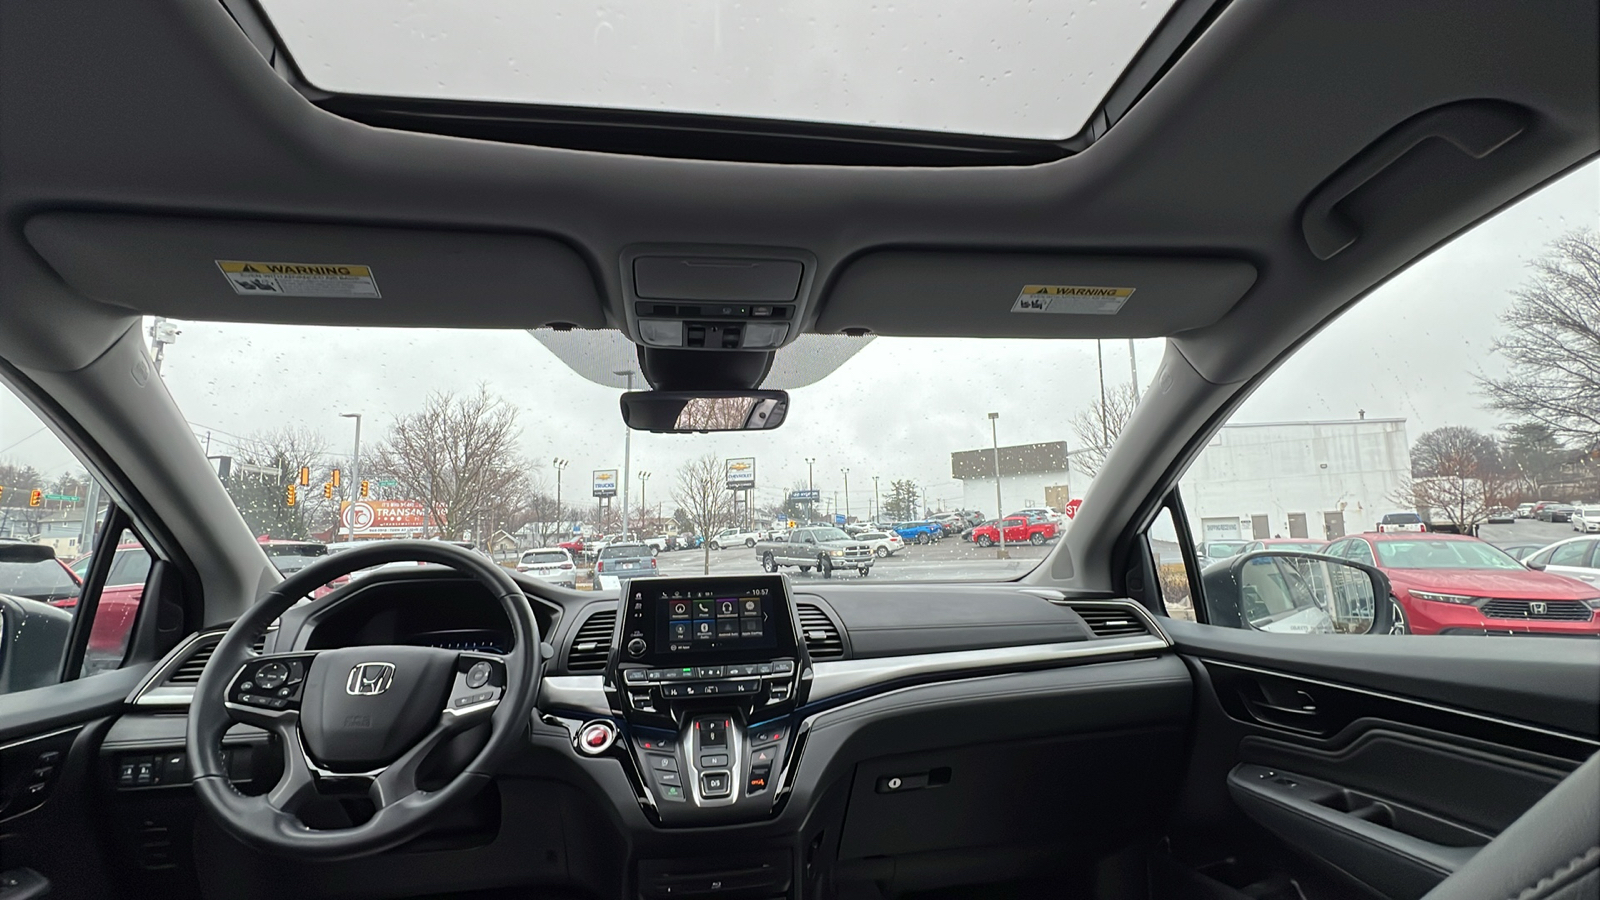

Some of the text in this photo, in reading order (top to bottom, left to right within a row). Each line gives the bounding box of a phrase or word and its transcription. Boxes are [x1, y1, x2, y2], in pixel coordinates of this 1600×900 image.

[266, 264, 351, 275] WARNING
[1056, 287, 1118, 296] WARNING
[1066, 505, 1078, 515] ST
[752, 588, 769, 596] 10:57
[710, 779, 721, 787] D/S
